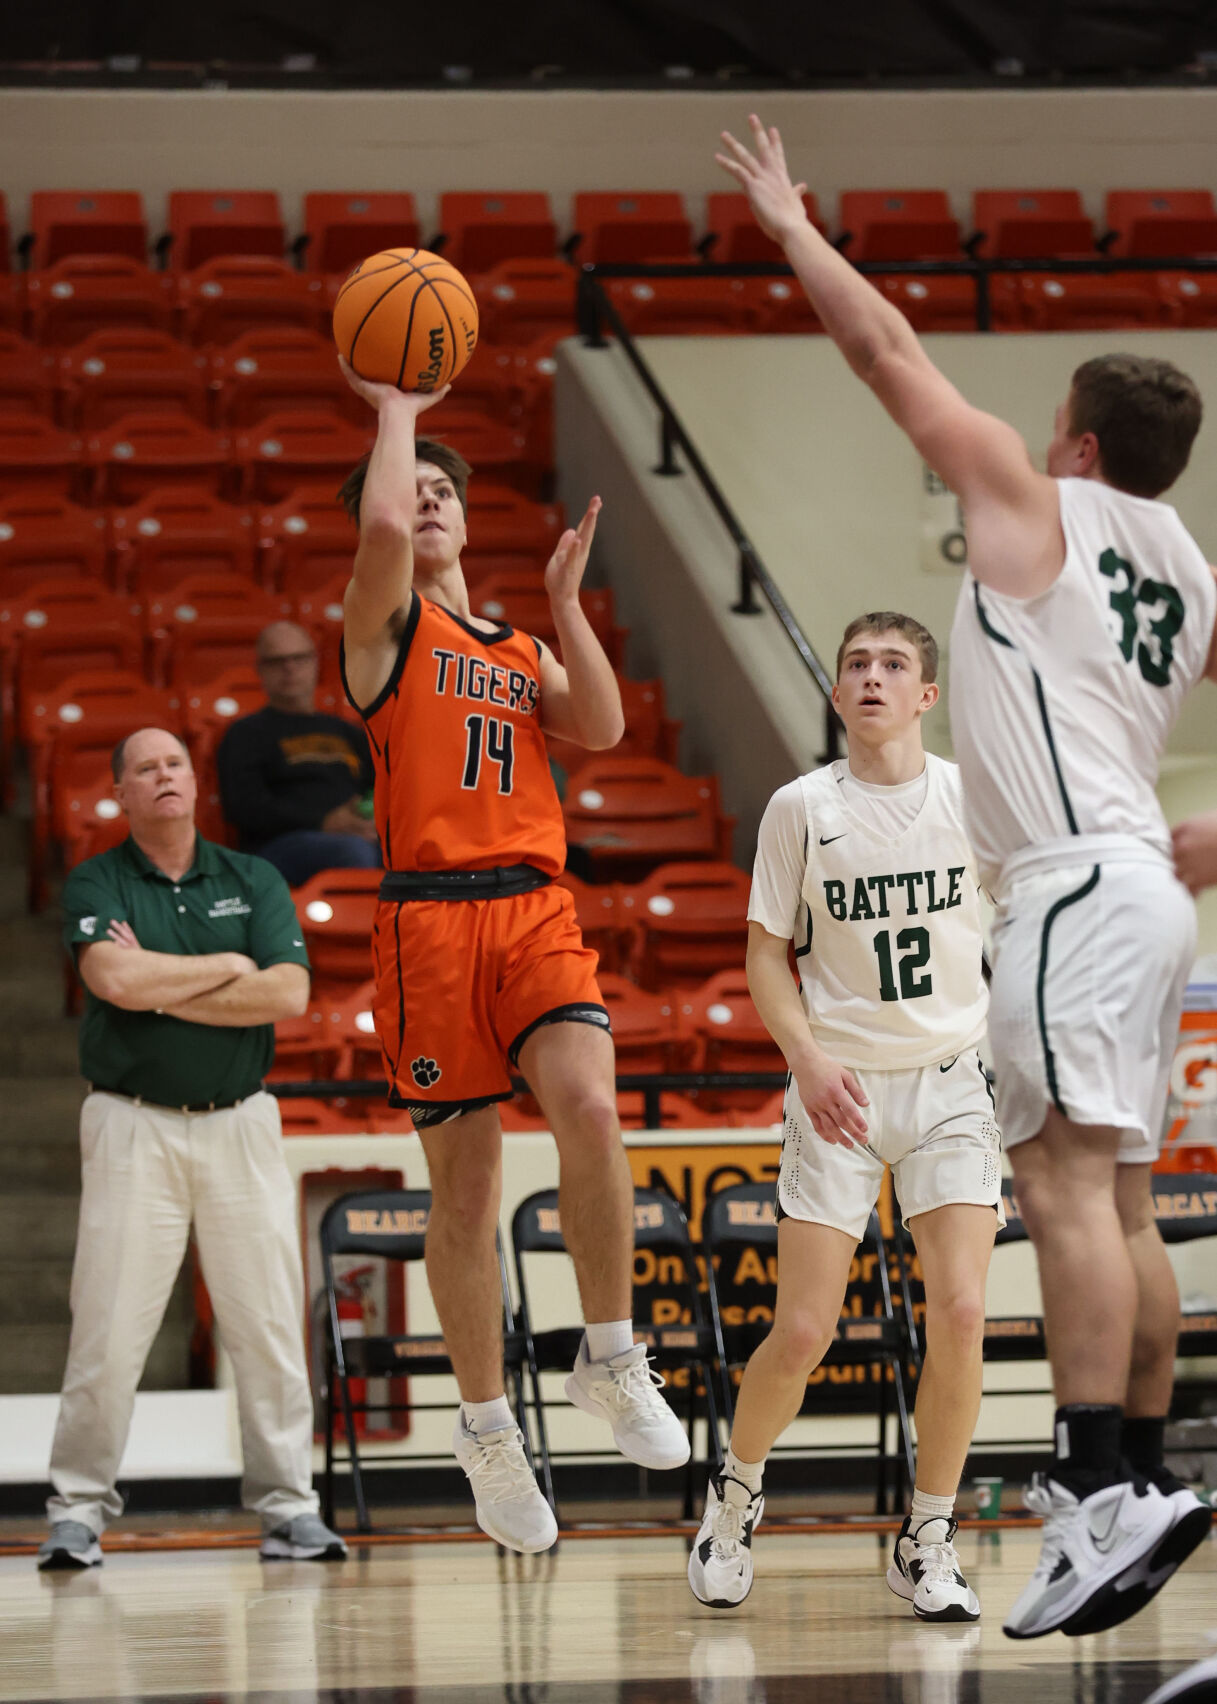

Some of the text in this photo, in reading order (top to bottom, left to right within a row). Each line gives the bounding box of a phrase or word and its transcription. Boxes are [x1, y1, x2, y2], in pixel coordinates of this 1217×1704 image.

[1098, 547, 1185, 687] 33
[432, 647, 540, 715] TIGERS
[460, 713, 515, 796] 14
[823, 866, 966, 922] BATTLE
[873, 926, 933, 1002] 12
[346, 1209, 429, 1235] BEARC
